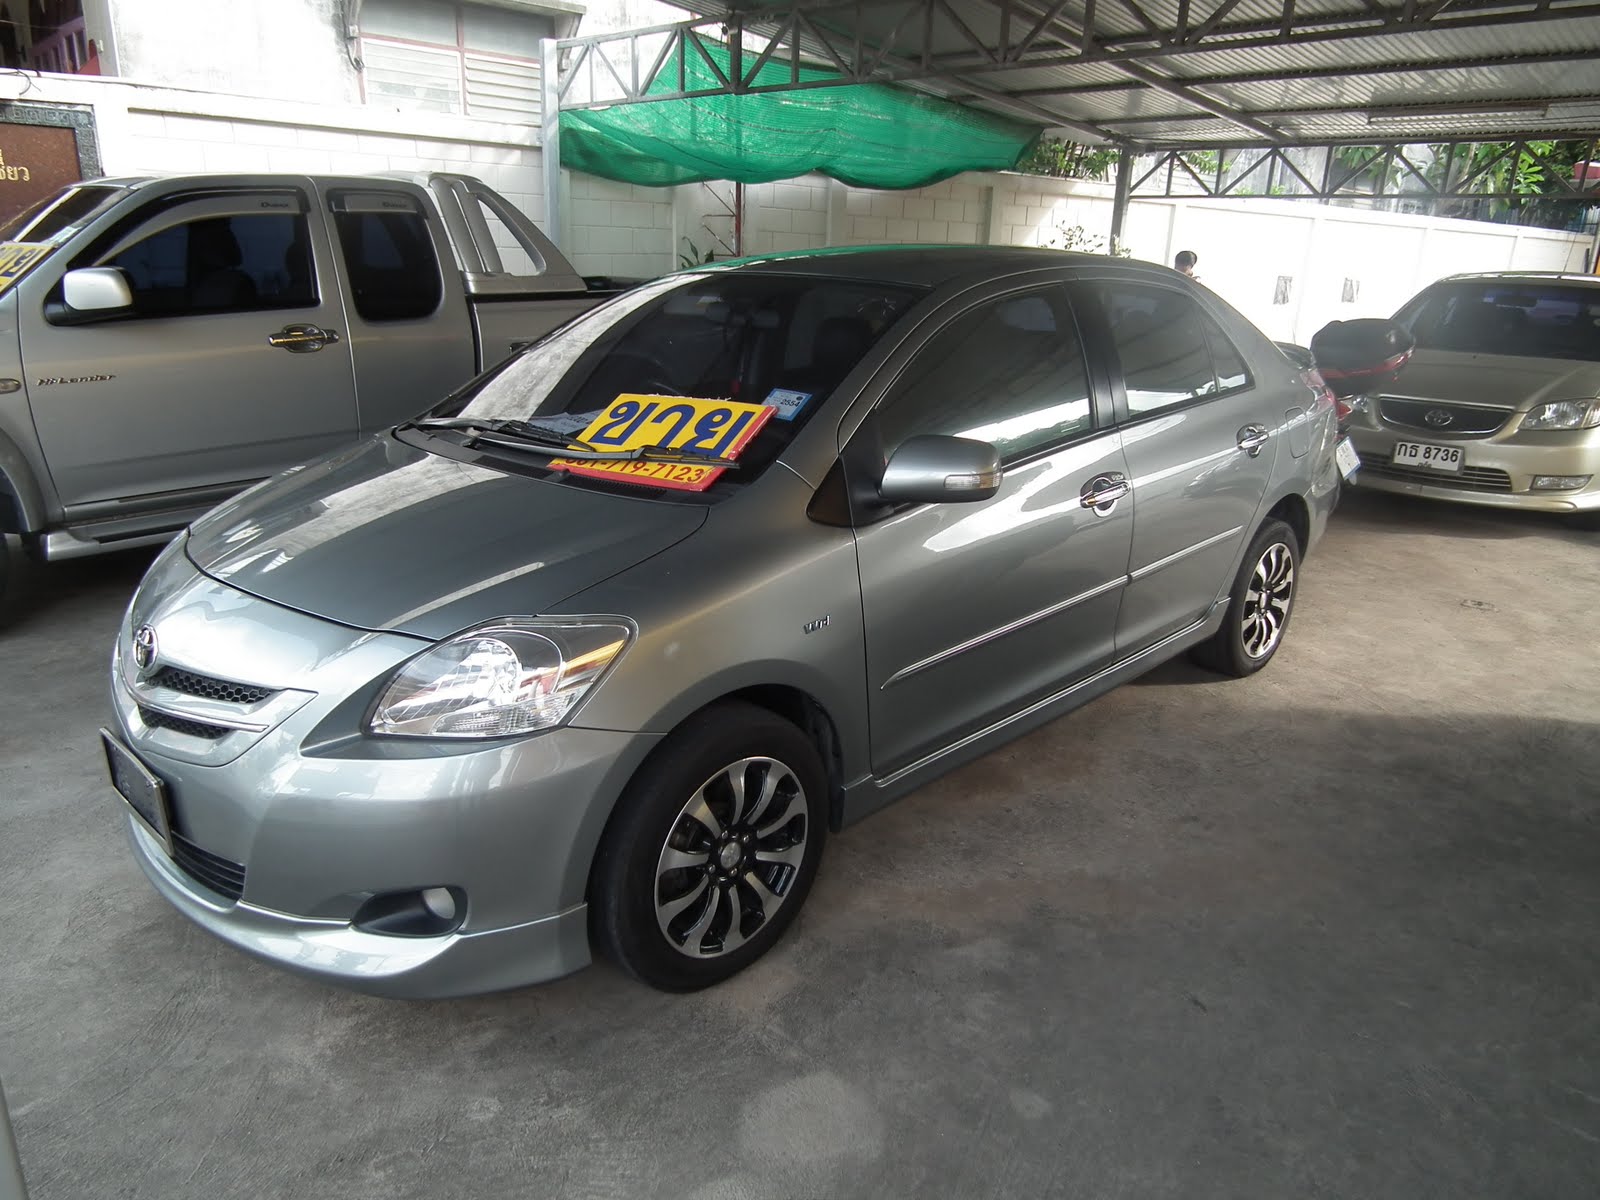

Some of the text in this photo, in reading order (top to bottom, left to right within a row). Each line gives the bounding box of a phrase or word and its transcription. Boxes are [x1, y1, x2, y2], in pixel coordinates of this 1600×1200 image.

[587, 400, 756, 458] ขาย
[1397, 443, 1460, 462] กธ 8736
